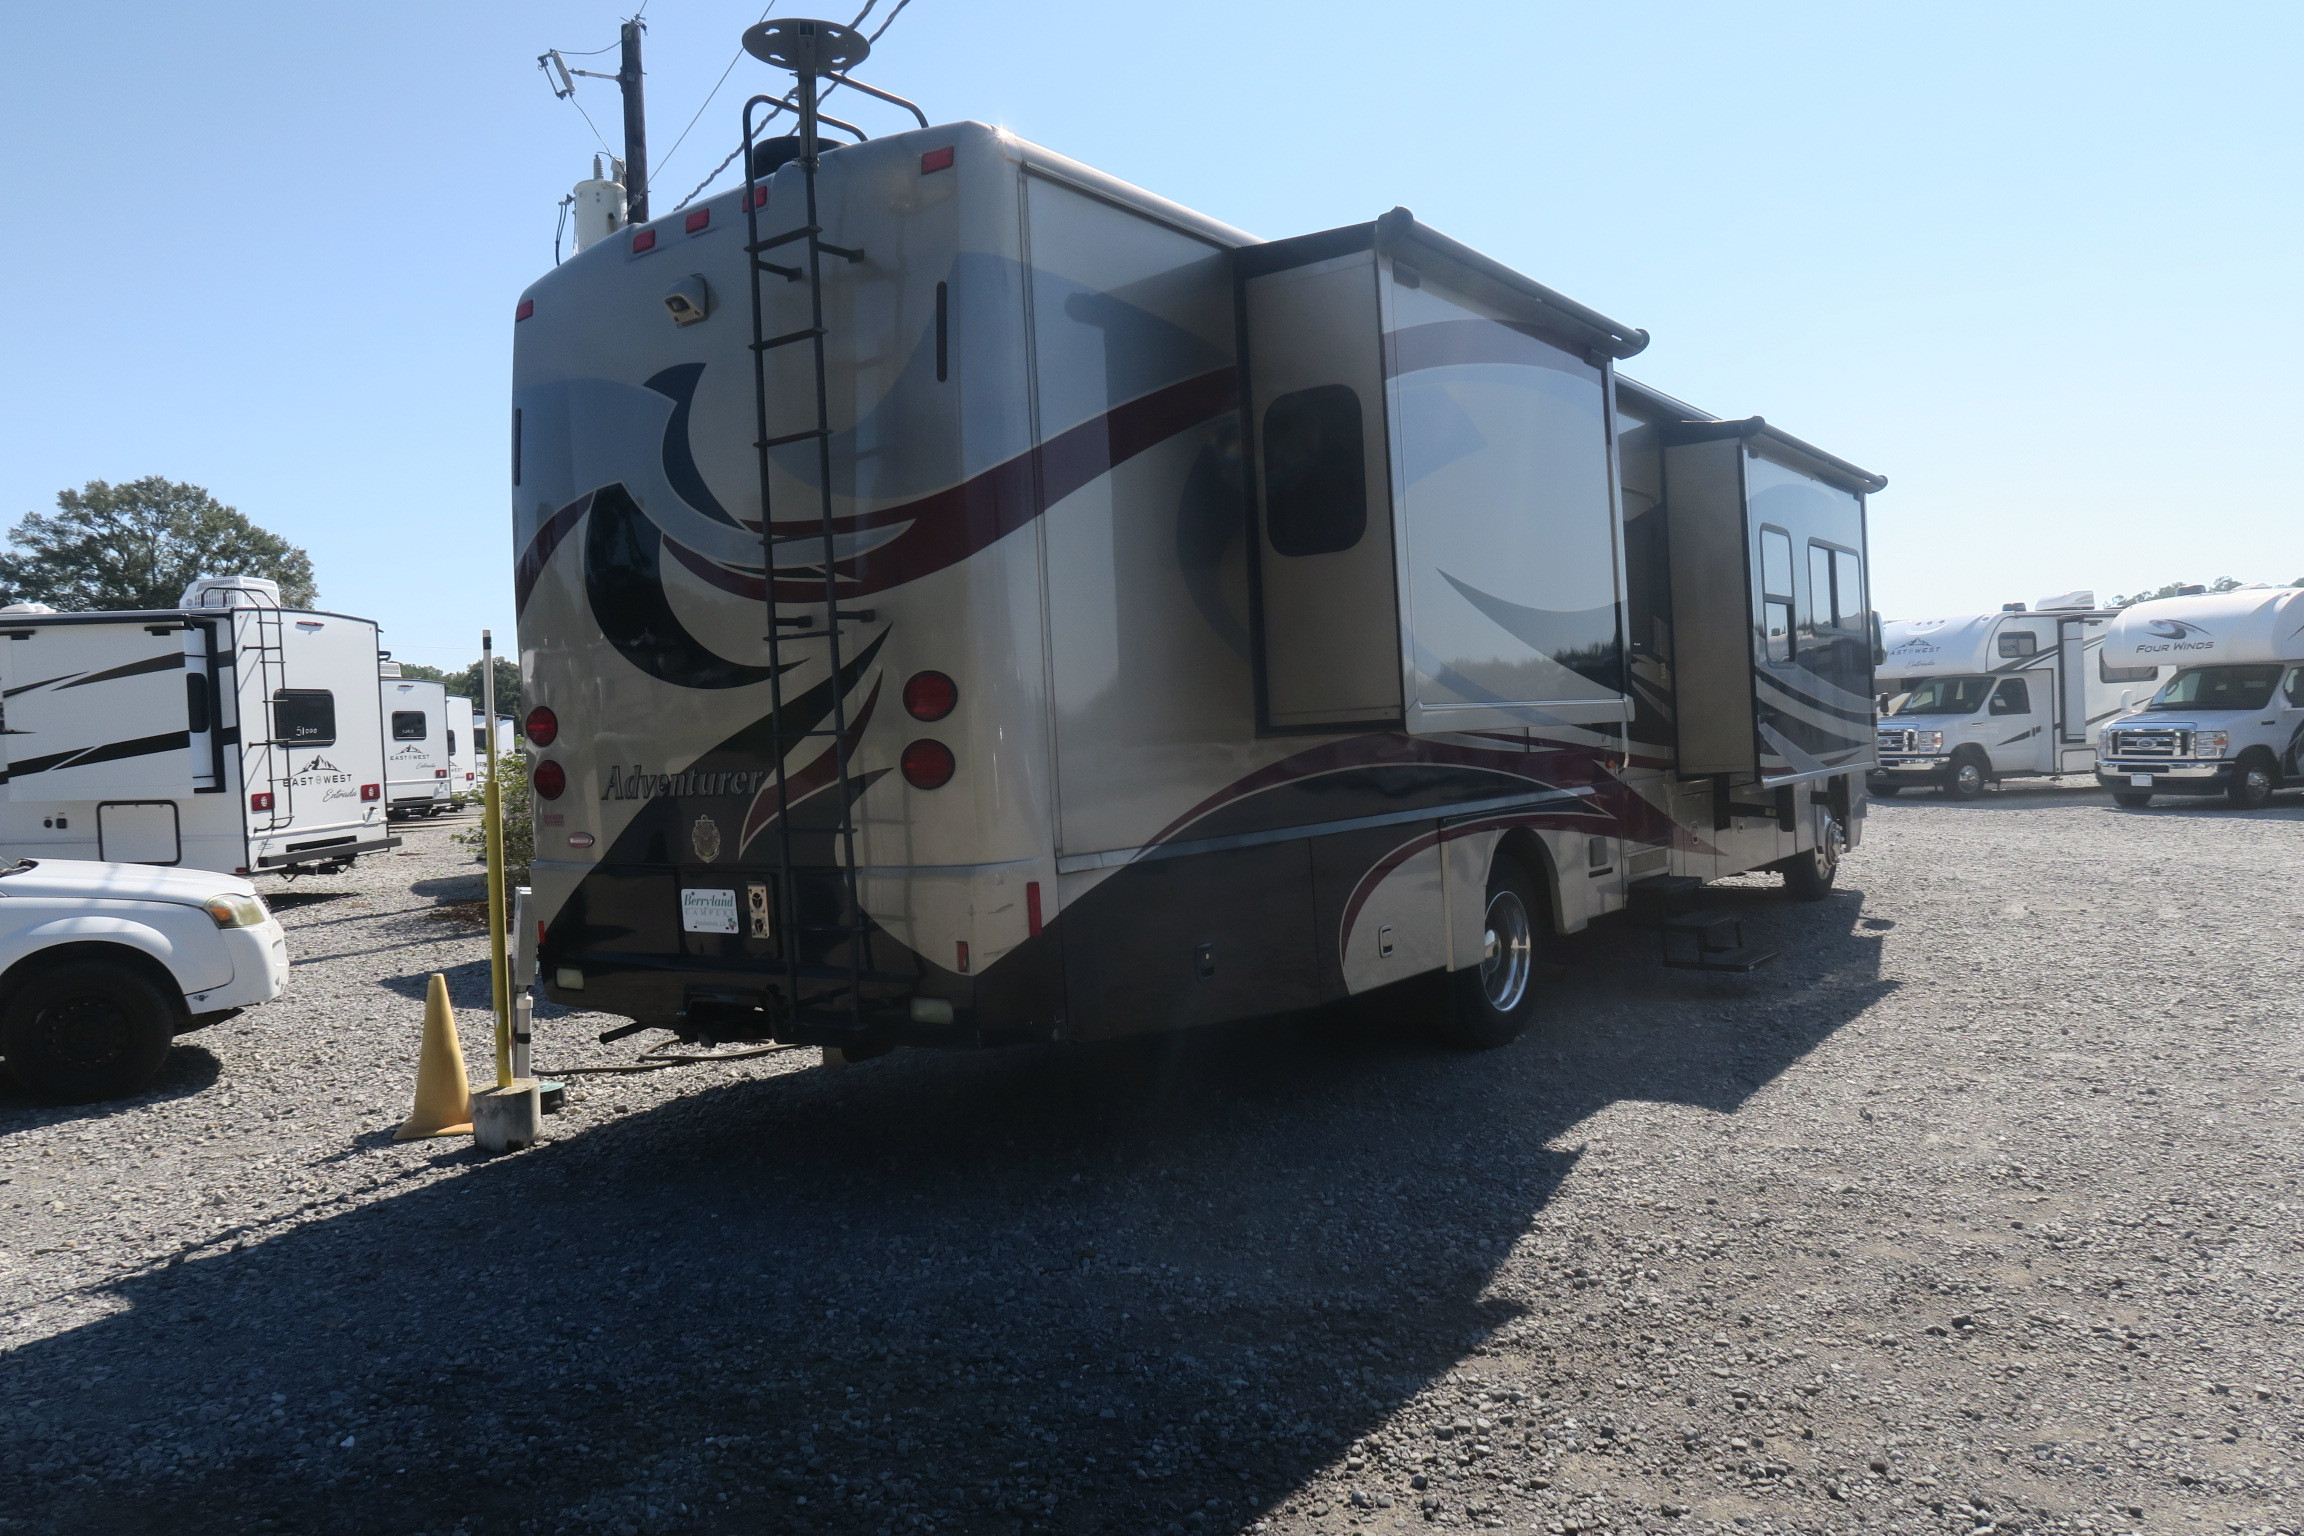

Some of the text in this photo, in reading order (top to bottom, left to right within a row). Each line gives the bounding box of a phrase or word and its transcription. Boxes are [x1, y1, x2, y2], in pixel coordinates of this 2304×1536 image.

[1914, 646, 1941, 654] WEST
[2136, 641, 2214, 653] FOUR WINDS
[282, 776, 314, 788] EAST
[323, 773, 352, 784] WEST
[601, 765, 764, 800] Adventurer
[322, 787, 357, 803] Entrada
[684, 894, 734, 908] Berryland
[684, 908, 735, 917] CAMPERS
